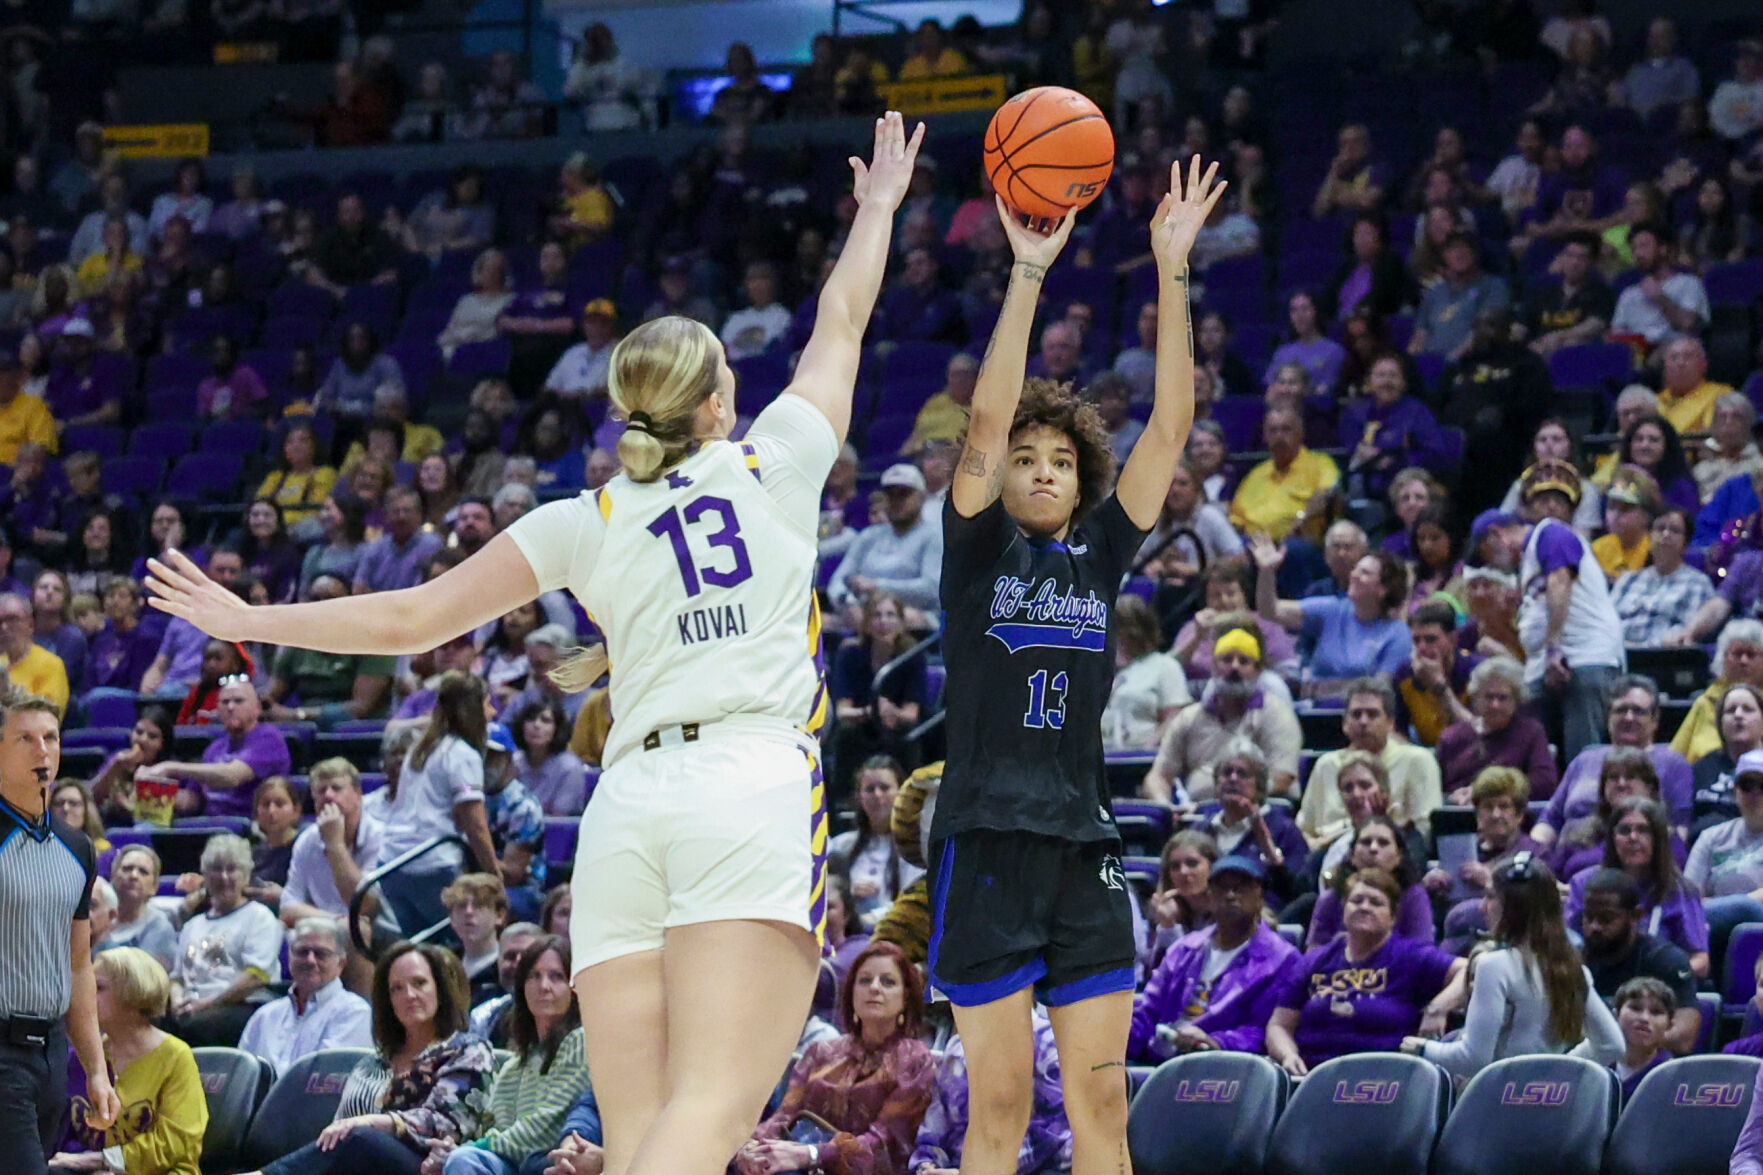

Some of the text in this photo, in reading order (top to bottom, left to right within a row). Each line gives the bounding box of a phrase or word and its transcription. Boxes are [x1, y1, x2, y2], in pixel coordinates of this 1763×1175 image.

[646, 494, 753, 599] 13
[676, 602, 748, 646] KOVAL
[1023, 669, 1069, 730] 13
[1174, 1080, 1239, 1102] LSU
[1332, 1080, 1400, 1104] LSU
[1500, 1081, 1569, 1106] LSU
[1673, 1083, 1745, 1107] LSU
